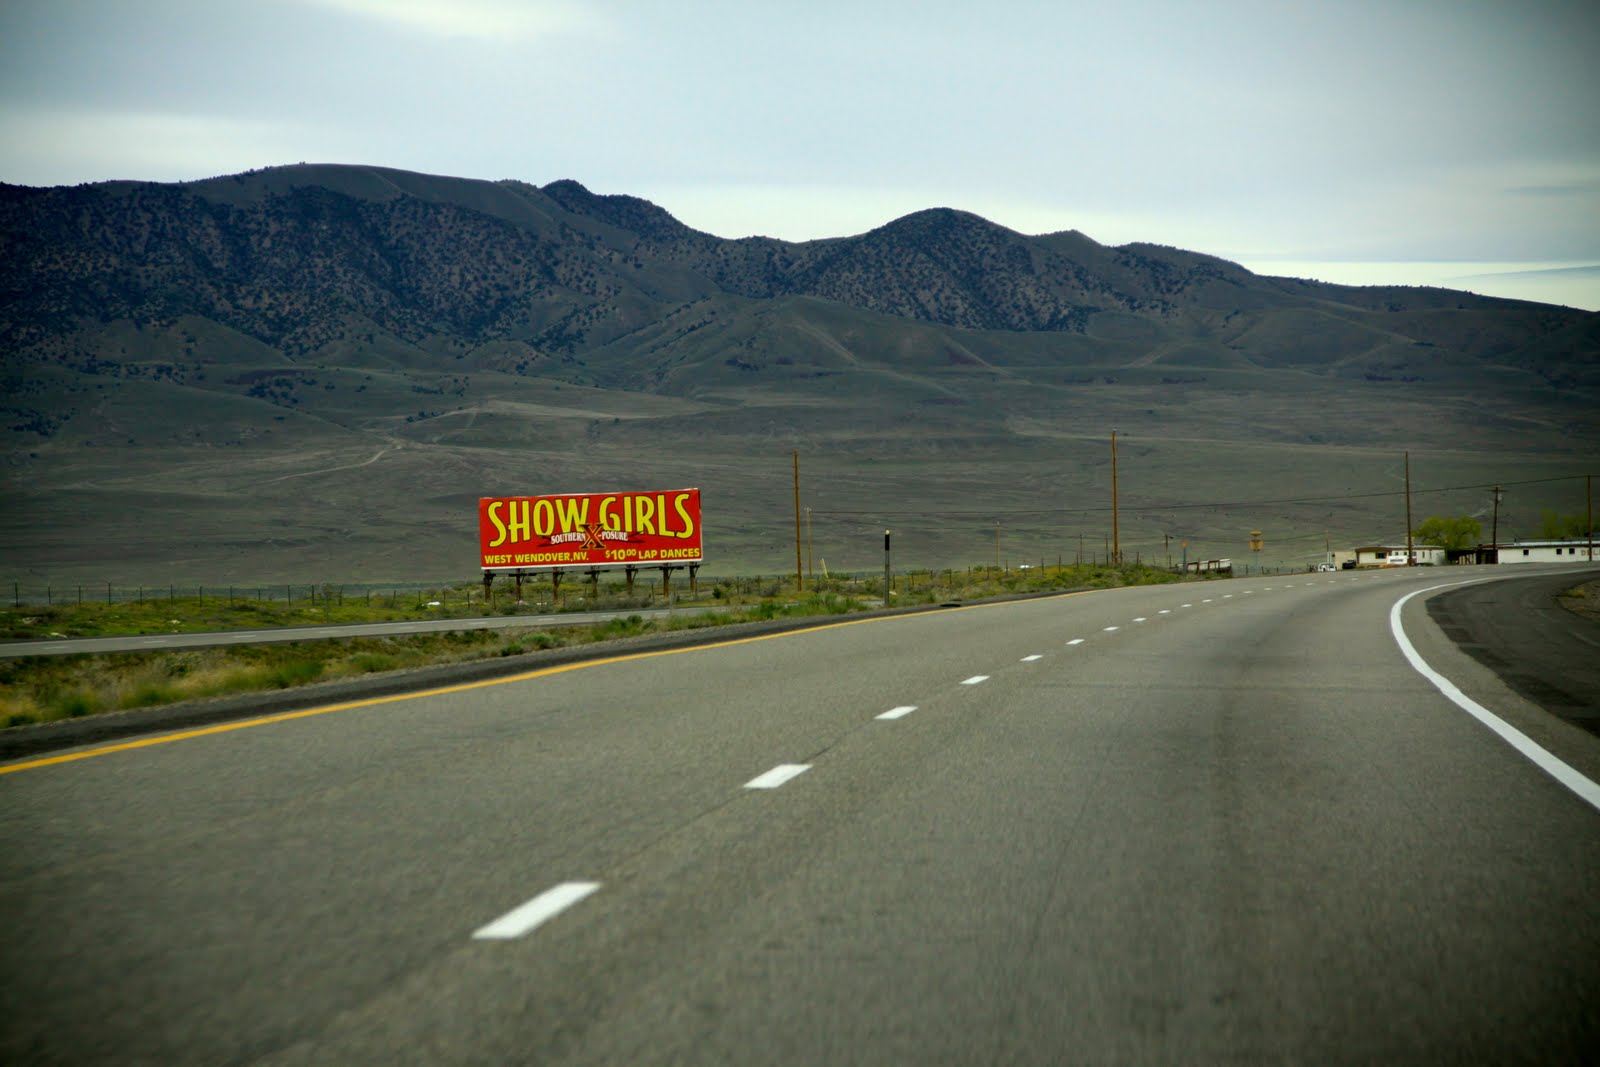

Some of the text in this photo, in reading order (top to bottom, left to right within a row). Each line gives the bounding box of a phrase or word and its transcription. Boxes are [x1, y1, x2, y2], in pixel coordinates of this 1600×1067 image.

[488, 493, 694, 547] SHOW GIRLS
[550, 532, 586, 545] SOUTHERN
[485, 554, 512, 564] WEST
[638, 550, 657, 560] LAP
[660, 548, 700, 558] DANCES
